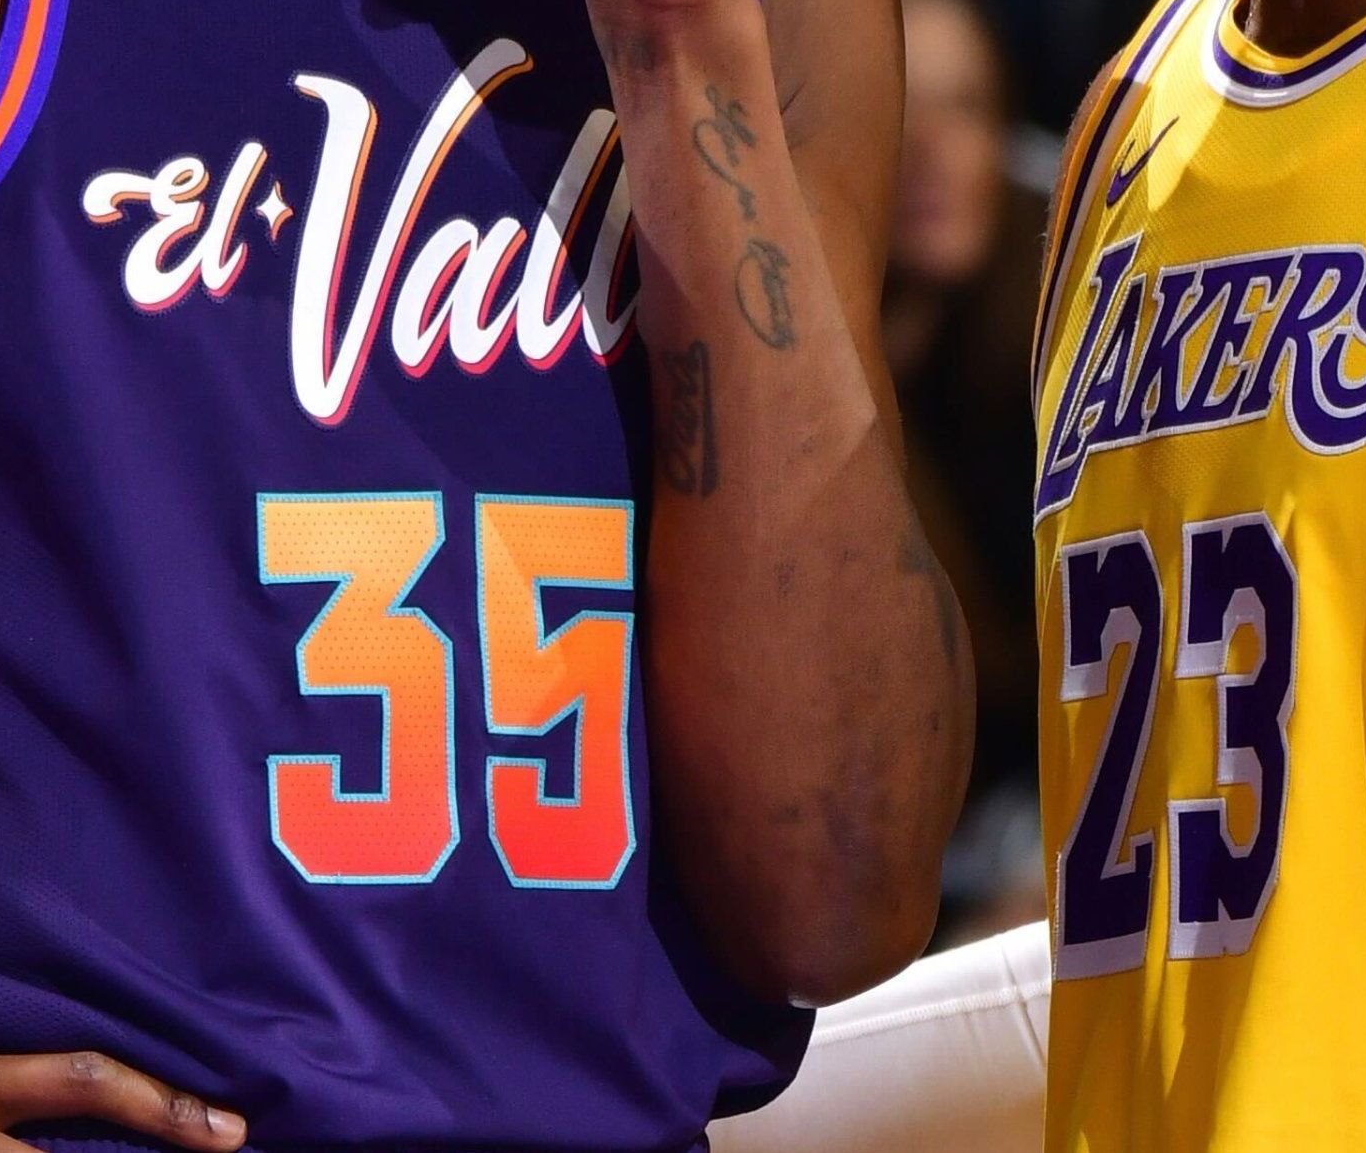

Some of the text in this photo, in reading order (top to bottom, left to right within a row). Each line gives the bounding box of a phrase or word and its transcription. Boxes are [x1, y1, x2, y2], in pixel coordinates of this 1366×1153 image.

[82, 142, 267, 312] El
[290, 37, 641, 427] Vall
[256, 491, 636, 890] 35
[1054, 510, 1299, 980] 23
